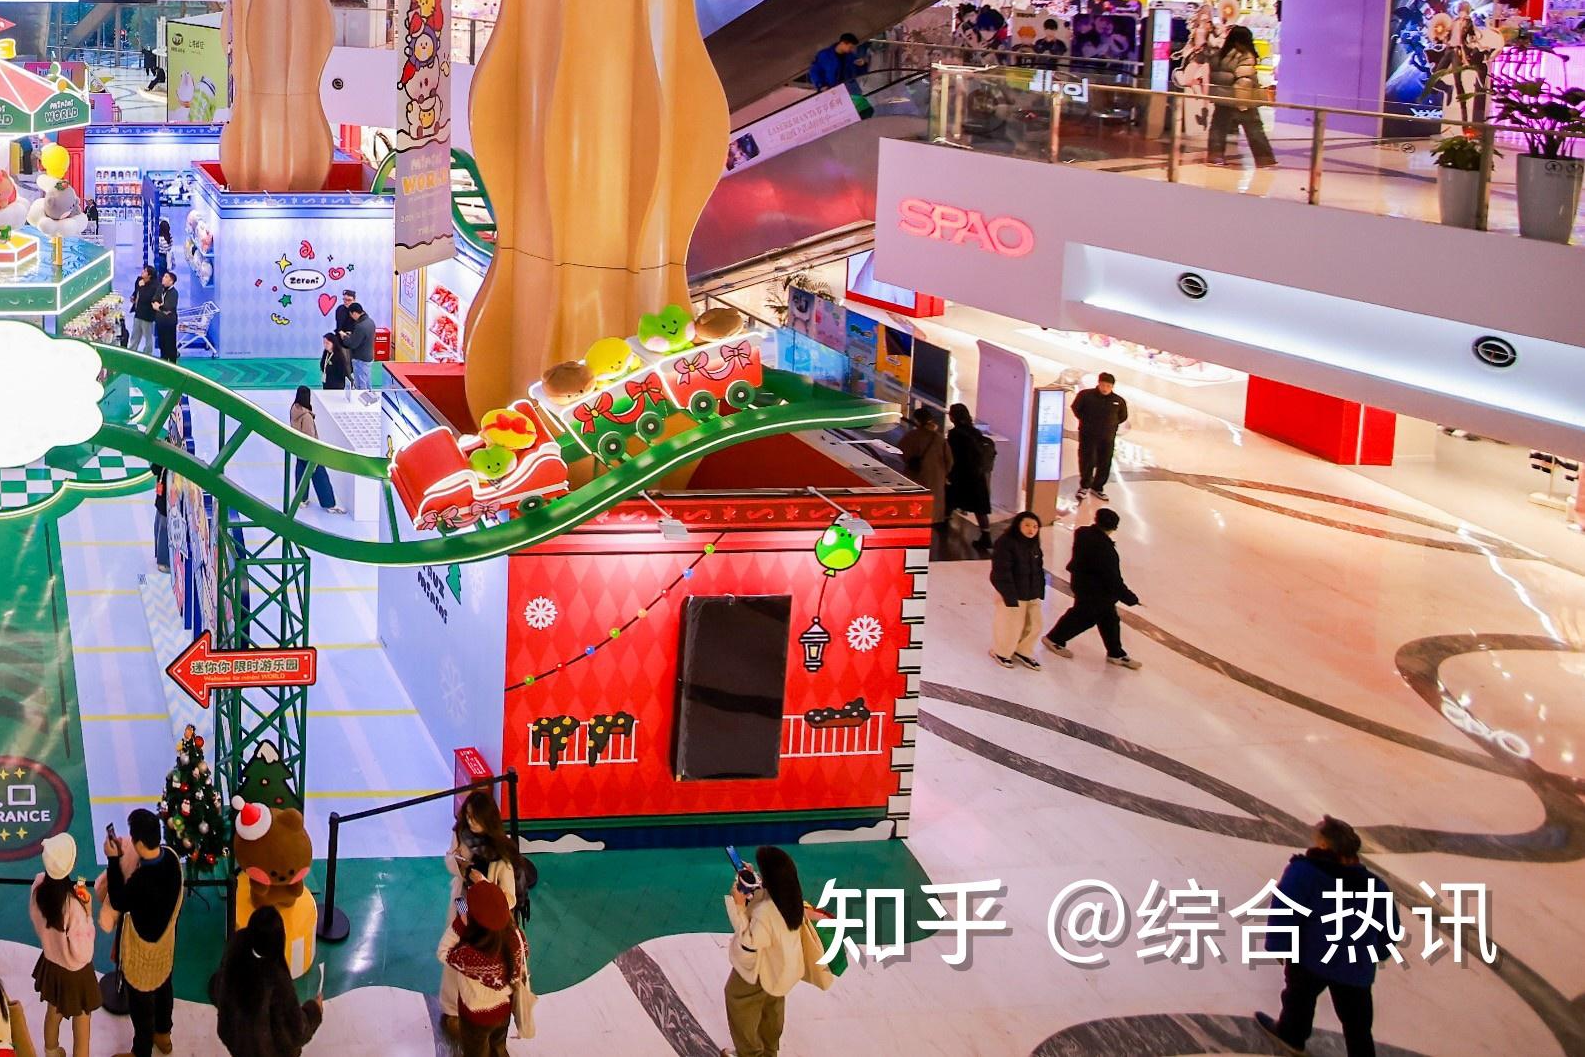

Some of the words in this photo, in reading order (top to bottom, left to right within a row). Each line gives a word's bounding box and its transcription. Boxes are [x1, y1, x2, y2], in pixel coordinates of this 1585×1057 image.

[49, 99, 75, 110] minini
[45, 107, 79, 122] WORLD
[897, 196, 1034, 258] SPAO
[188, 660, 232, 676] 迷你你
[232, 657, 300, 674] 限时游乐园
